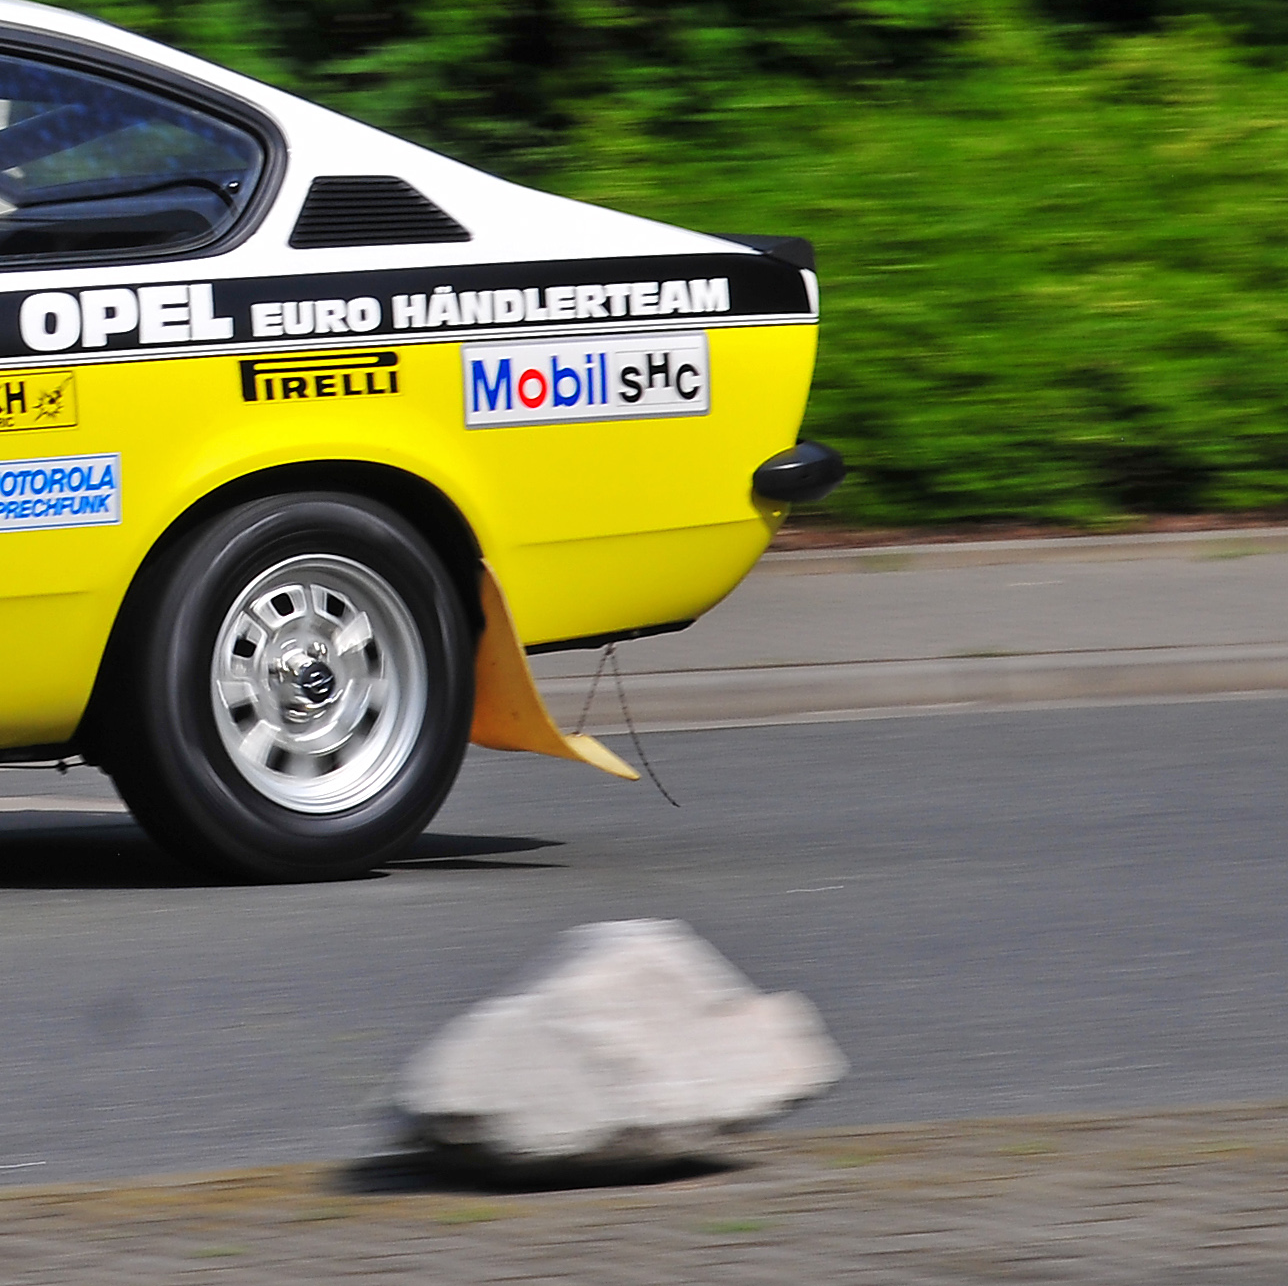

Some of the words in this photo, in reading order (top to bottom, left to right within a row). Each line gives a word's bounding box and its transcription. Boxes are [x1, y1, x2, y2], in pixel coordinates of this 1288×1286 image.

[19, 282, 234, 352] OPEL
[251, 296, 381, 337] EURO
[392, 278, 731, 329] HÄNDLERTEAM
[239, 350, 399, 401] PIRELLI
[471, 352, 608, 413] Mobil
